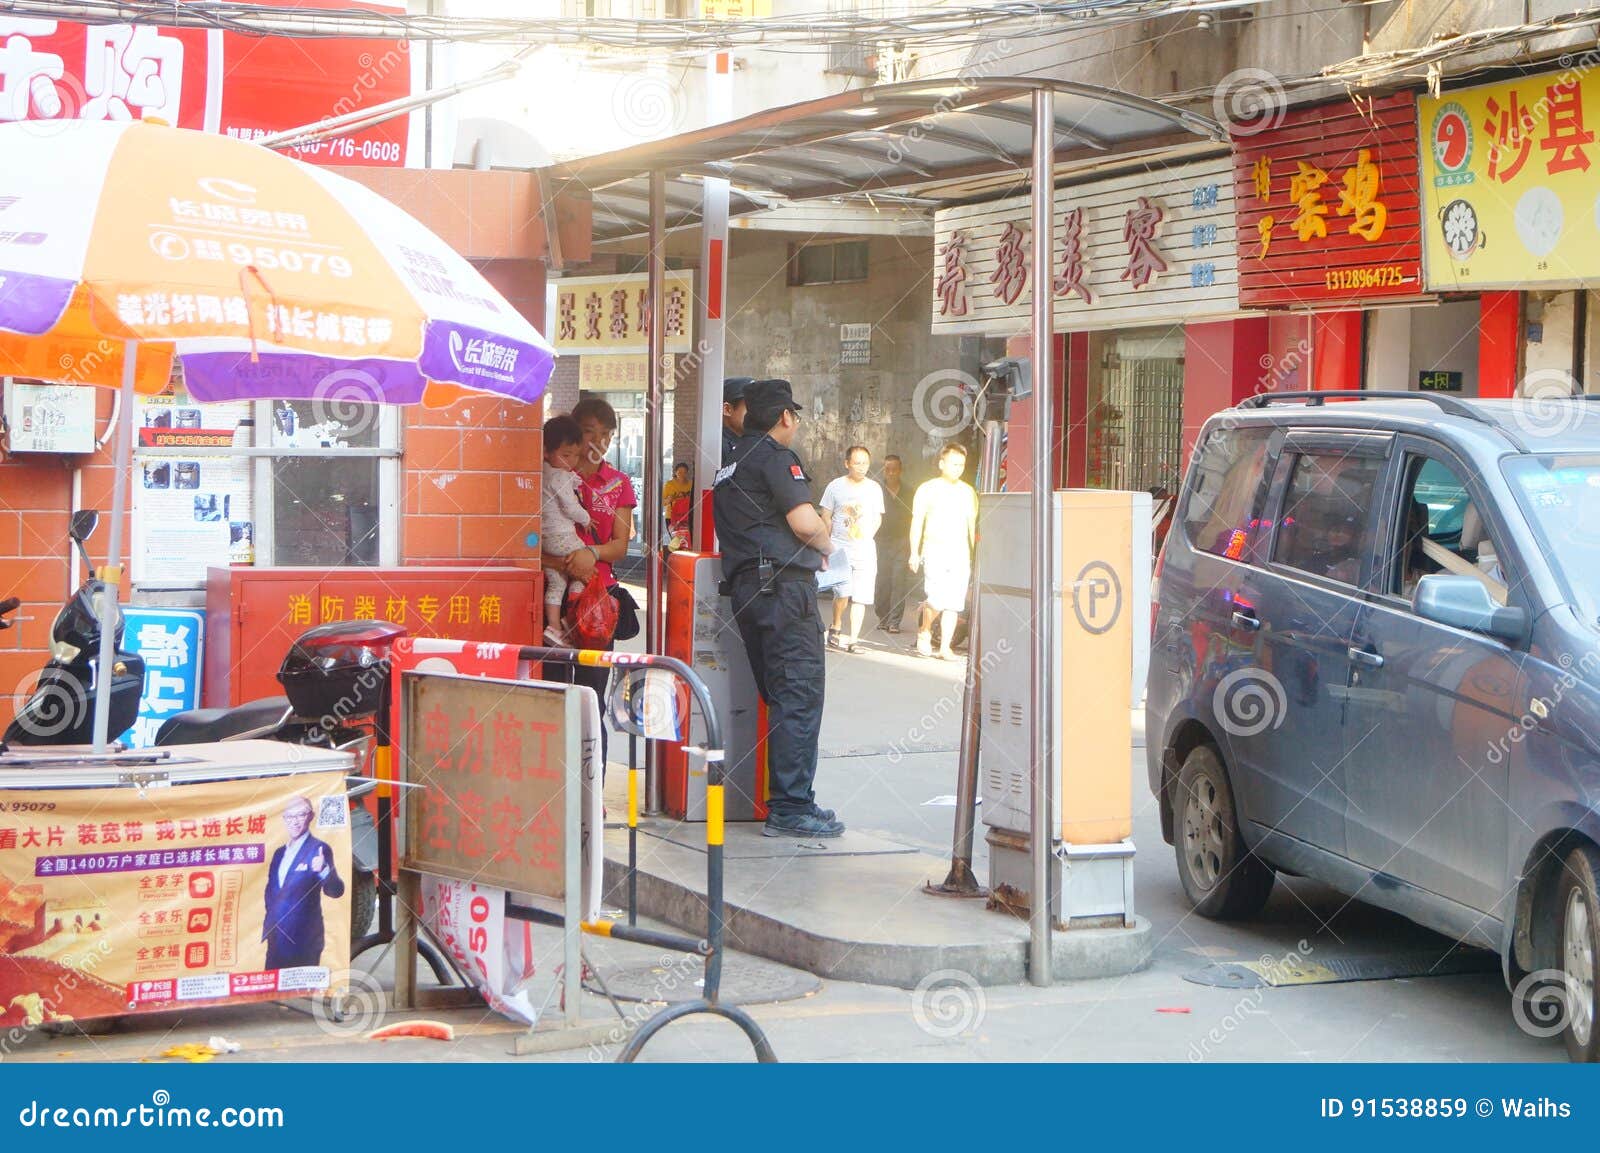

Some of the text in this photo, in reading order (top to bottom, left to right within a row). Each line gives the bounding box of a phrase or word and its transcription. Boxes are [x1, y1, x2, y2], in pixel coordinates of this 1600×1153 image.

[1483, 81, 1594, 184] 沙县
[227, 243, 353, 279] 95079
[1325, 266, 1403, 290] 13128964725
[463, 338, 519, 372] 长城宽带
[288, 594, 502, 625] 消防器材专用箱
[424, 703, 561, 782] 电力施工
[11, 802, 56, 812] 95079
[0, 814, 267, 849] 看大片 装宽带 我只选长城
[421, 785, 561, 871] 注意安全
[40, 846, 259, 873] 全国1400万户家庭已选择长城宽带
[139, 873, 185, 890] 全家学
[138, 909, 184, 925] 全家乐
[136, 944, 181, 960] 全家福
